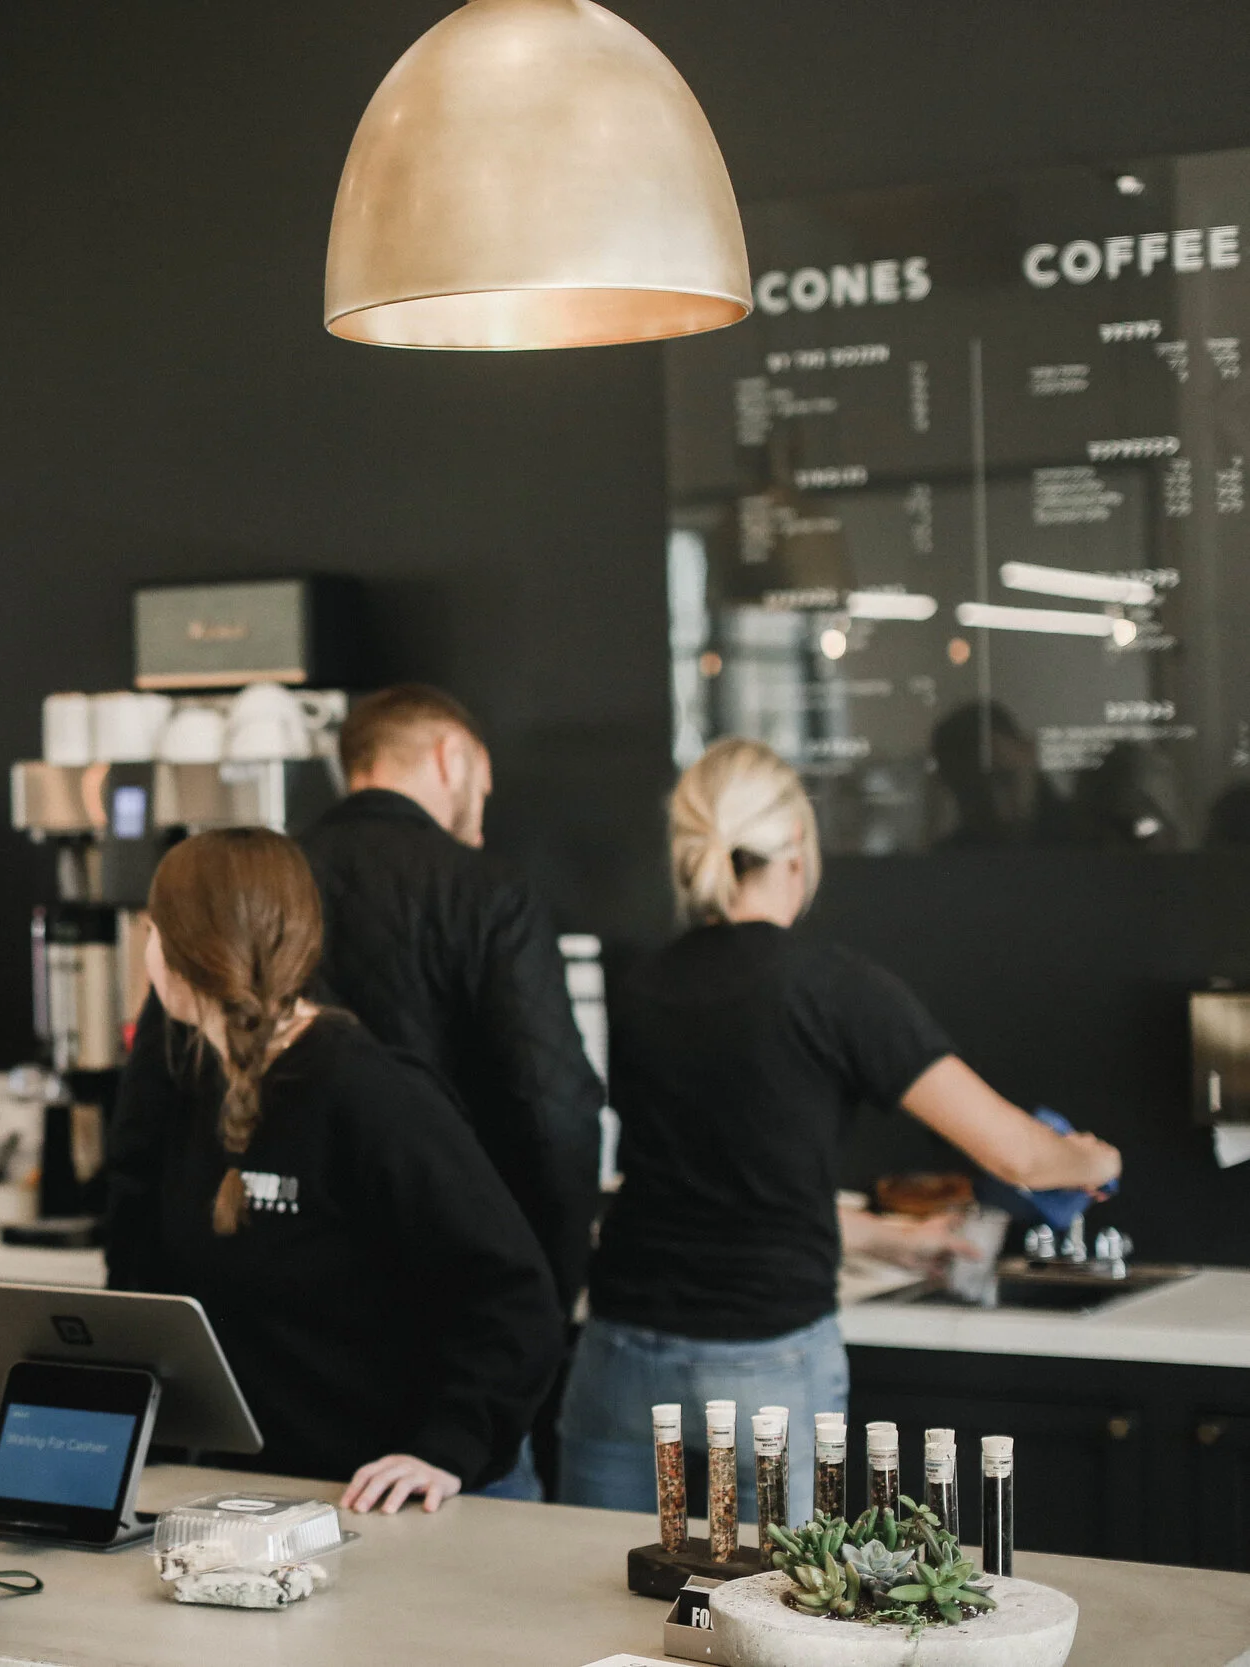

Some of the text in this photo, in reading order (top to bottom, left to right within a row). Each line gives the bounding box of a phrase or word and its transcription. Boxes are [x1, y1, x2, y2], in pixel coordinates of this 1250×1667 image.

[1023, 225, 1240, 288] COFFEE
[754, 255, 932, 316] CONES
[7, 1433, 46, 1450] Waiting
[49, 1436, 66, 1449] For
[692, 1606, 713, 1630] FO
